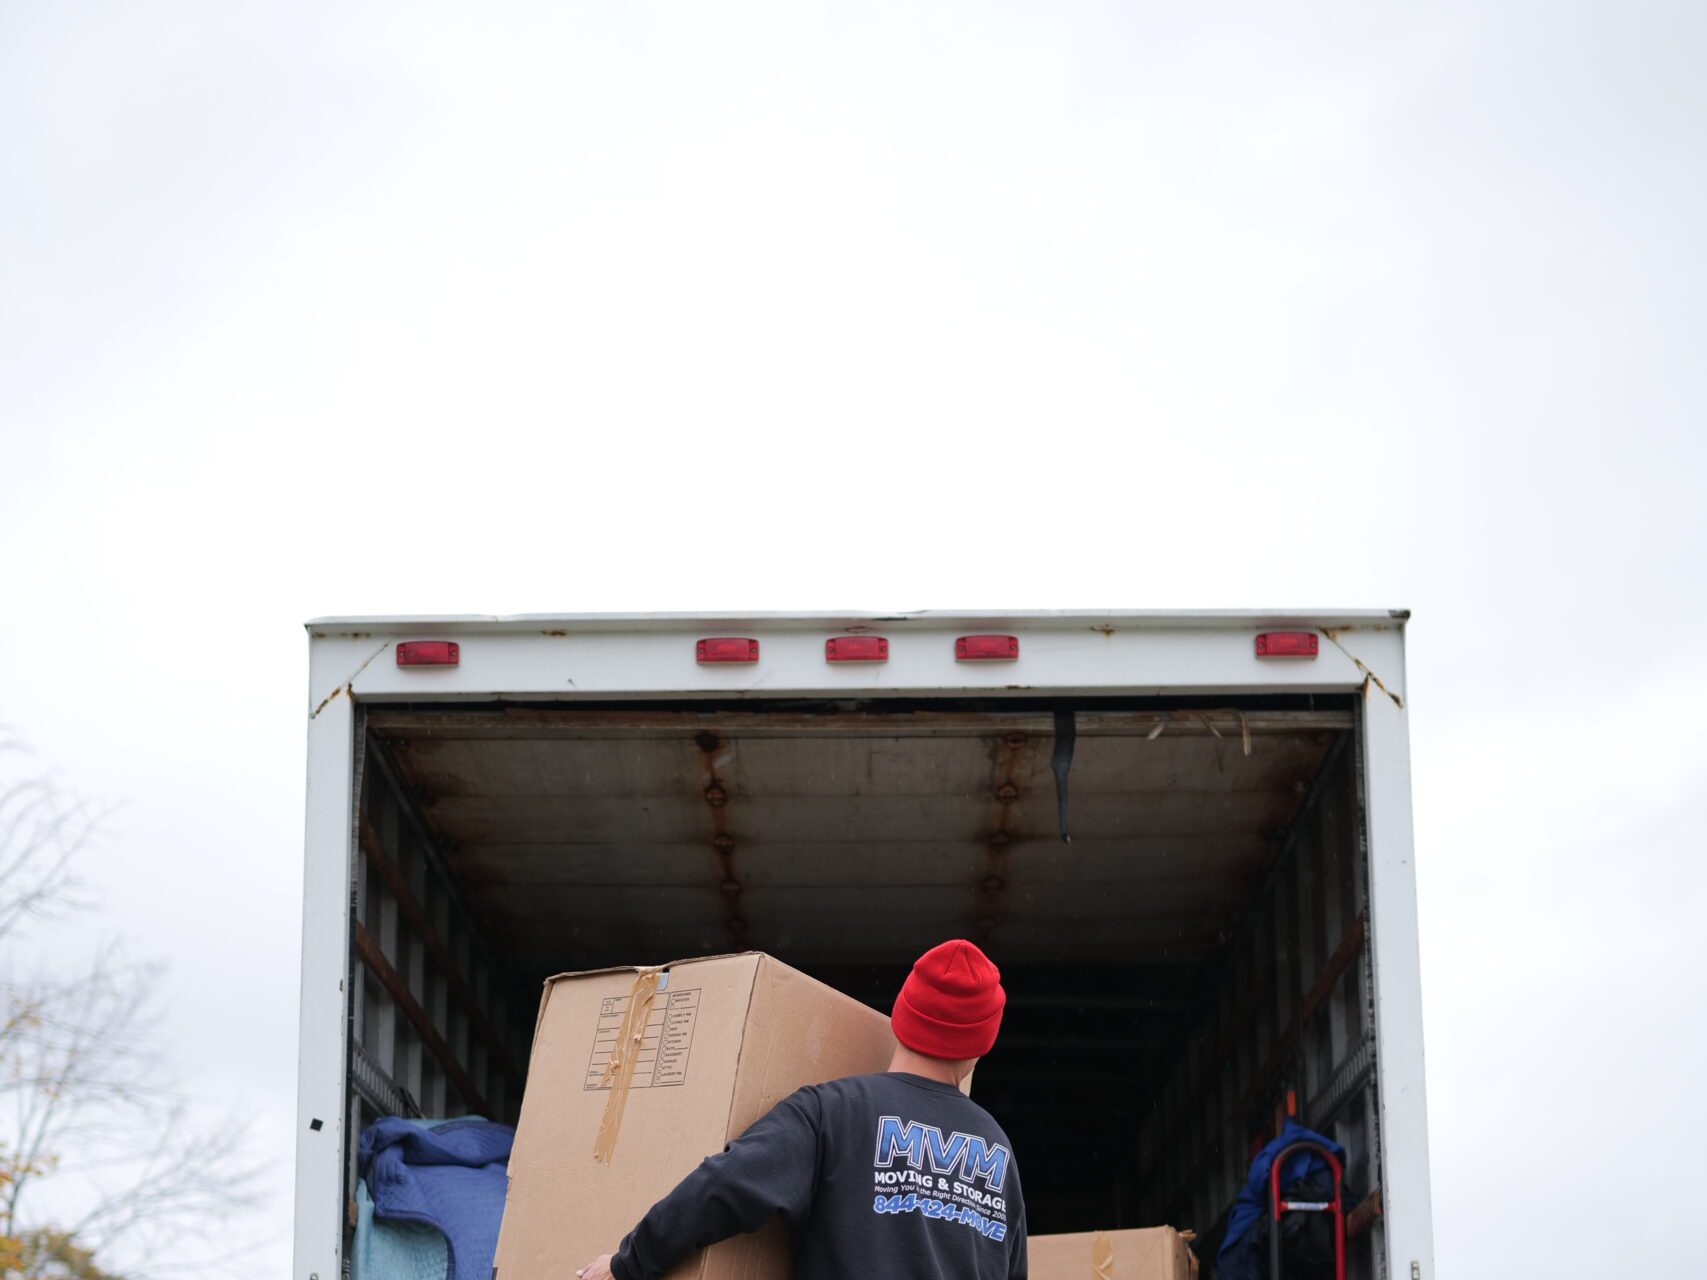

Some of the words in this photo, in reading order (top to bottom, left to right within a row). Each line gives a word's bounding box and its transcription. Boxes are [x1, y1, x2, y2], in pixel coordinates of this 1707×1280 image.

[874, 1115, 1010, 1193] MVM
[874, 1170, 933, 1188] MOVING
[937, 1177, 950, 1191] &
[953, 1181, 1007, 1213] STORAGE
[874, 1185, 899, 1194] Moving
[920, 1188, 931, 1196] the
[932, 1190, 951, 1200] Right
[873, 1193, 1007, 1242] 844-424-MOVE
